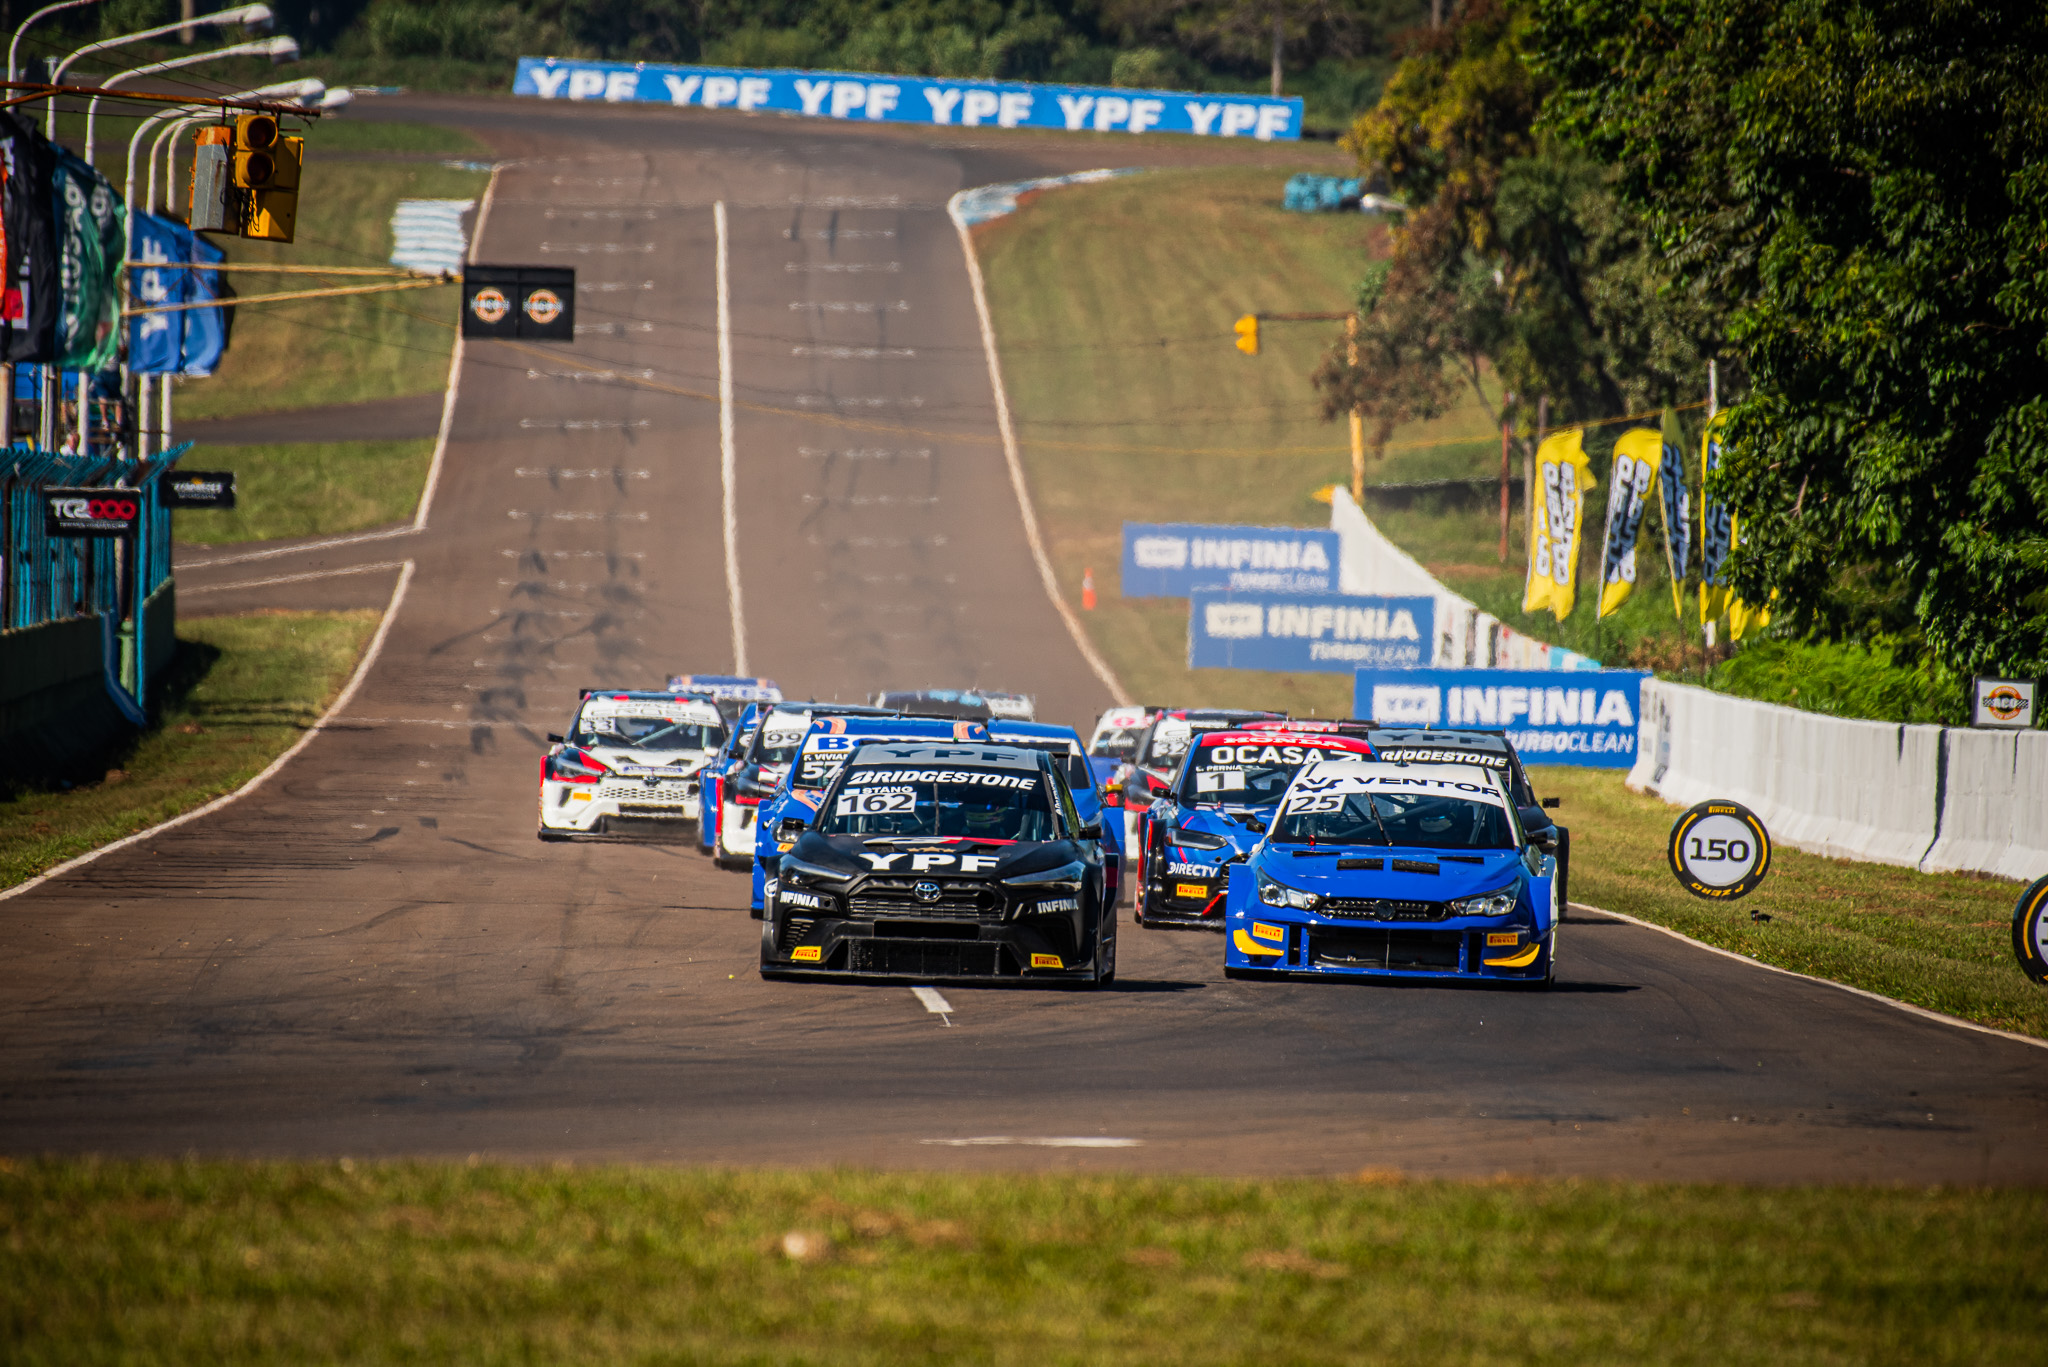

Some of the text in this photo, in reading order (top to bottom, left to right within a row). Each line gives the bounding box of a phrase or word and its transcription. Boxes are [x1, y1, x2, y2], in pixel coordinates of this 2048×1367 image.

[530, 68, 1291, 140] YPF YPF YPF YPF YPF YPF
[1190, 536, 1330, 571] INFINIA
[1267, 605, 1422, 641] INFINIA
[1447, 686, 1635, 727] INFINIA
[767, 733, 802, 745] 99
[1224, 737, 1347, 749] HONDA
[1383, 734, 1487, 744] YPF
[885, 749, 1019, 762] YPF
[1211, 746, 1325, 765] OCASA
[1380, 750, 1509, 767] RIDGESTONE
[801, 761, 844, 779] 57
[847, 770, 1037, 791] BRIDGESTONE
[1209, 772, 1225, 790] 1
[1353, 777, 1501, 797] VENTOR
[862, 786, 914, 794] STANG
[841, 793, 913, 812] 162
[1292, 796, 1340, 812] 25
[1708, 806, 1736, 814] PIRELLI
[1689, 837, 1750, 863] 150
[858, 853, 1000, 872] YPF
[1167, 862, 1219, 877] DIRECTV
[1037, 898, 1078, 914] INFINIA
